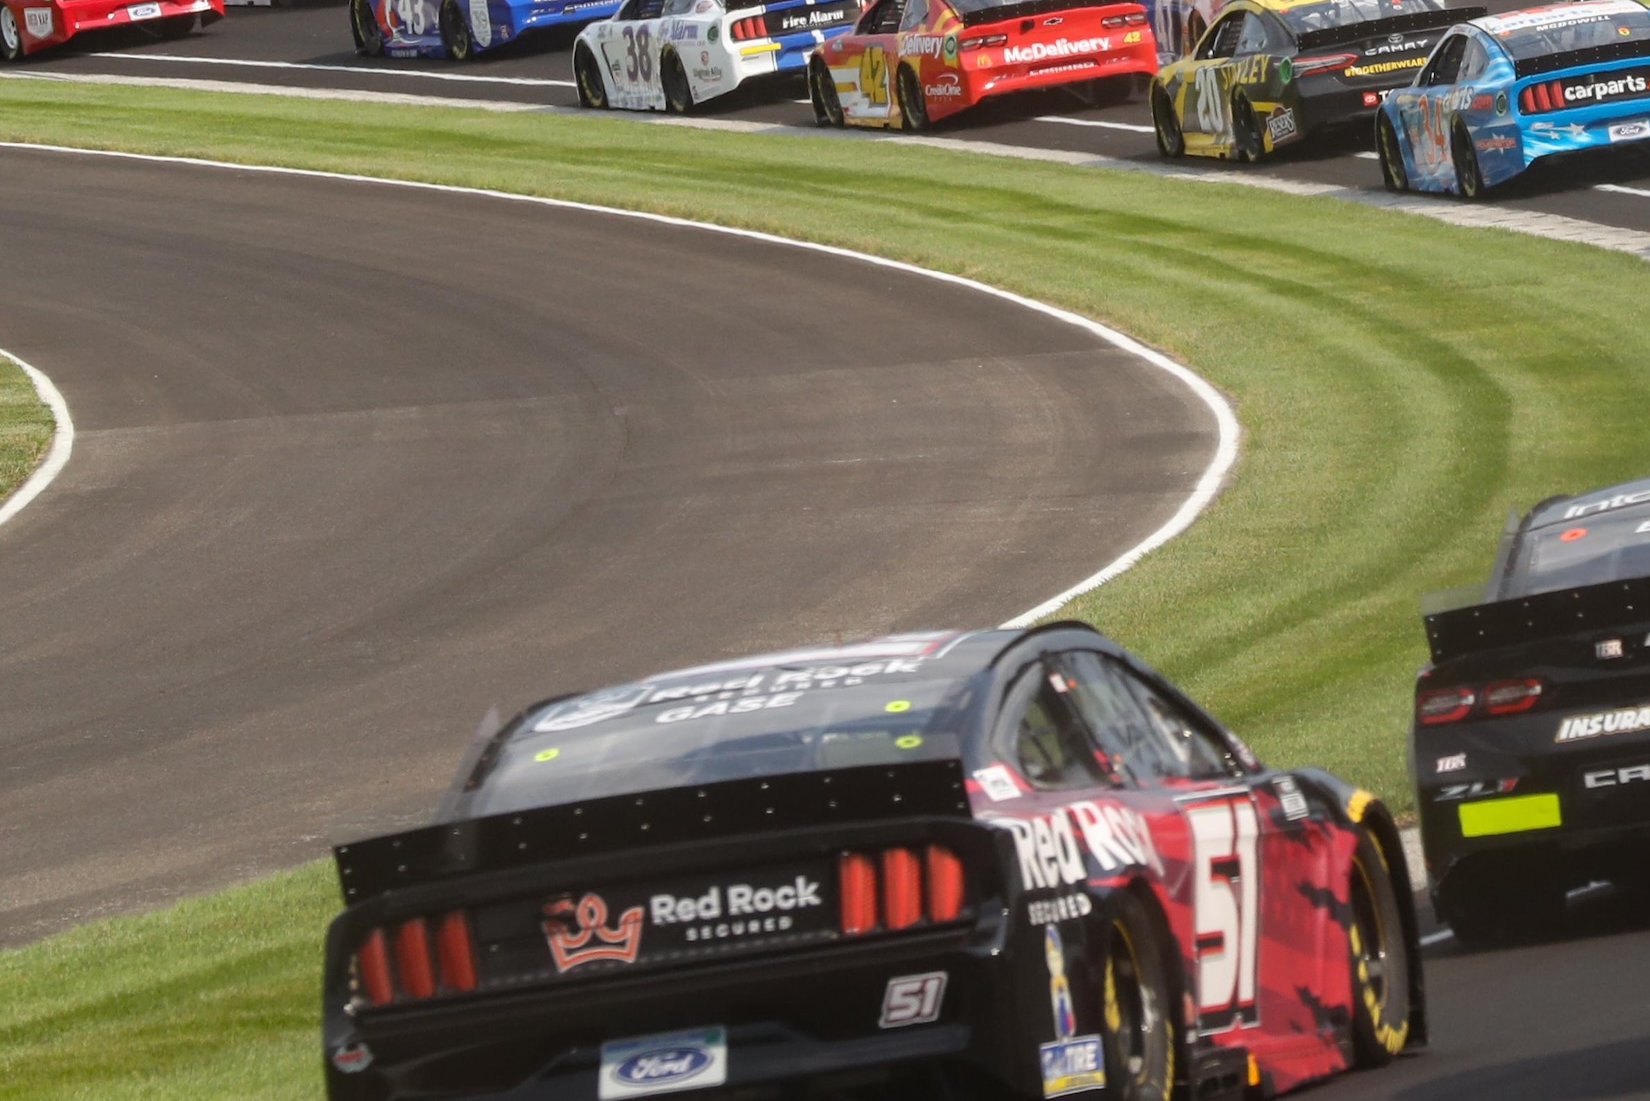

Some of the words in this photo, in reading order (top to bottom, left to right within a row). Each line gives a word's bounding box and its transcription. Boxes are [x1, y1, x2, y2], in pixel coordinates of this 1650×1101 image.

[1122, 30, 1143, 44] 42
[1536, 14, 1612, 32] MCDOWELL
[621, 25, 653, 83] 38
[900, 34, 944, 59] Delivery
[1003, 36, 1110, 63] McDelivery
[1364, 38, 1428, 56] CAMRY
[780, 657, 925, 686] Rock
[654, 691, 807, 725] GASE
[1010, 806, 1088, 892] Red
[650, 887, 722, 928] Red
[727, 875, 822, 917] Rock
[1187, 801, 1260, 1010] 51
[685, 915, 794, 943] SECURED
[883, 976, 945, 1024] 51
[630, 1052, 694, 1082] Ford
